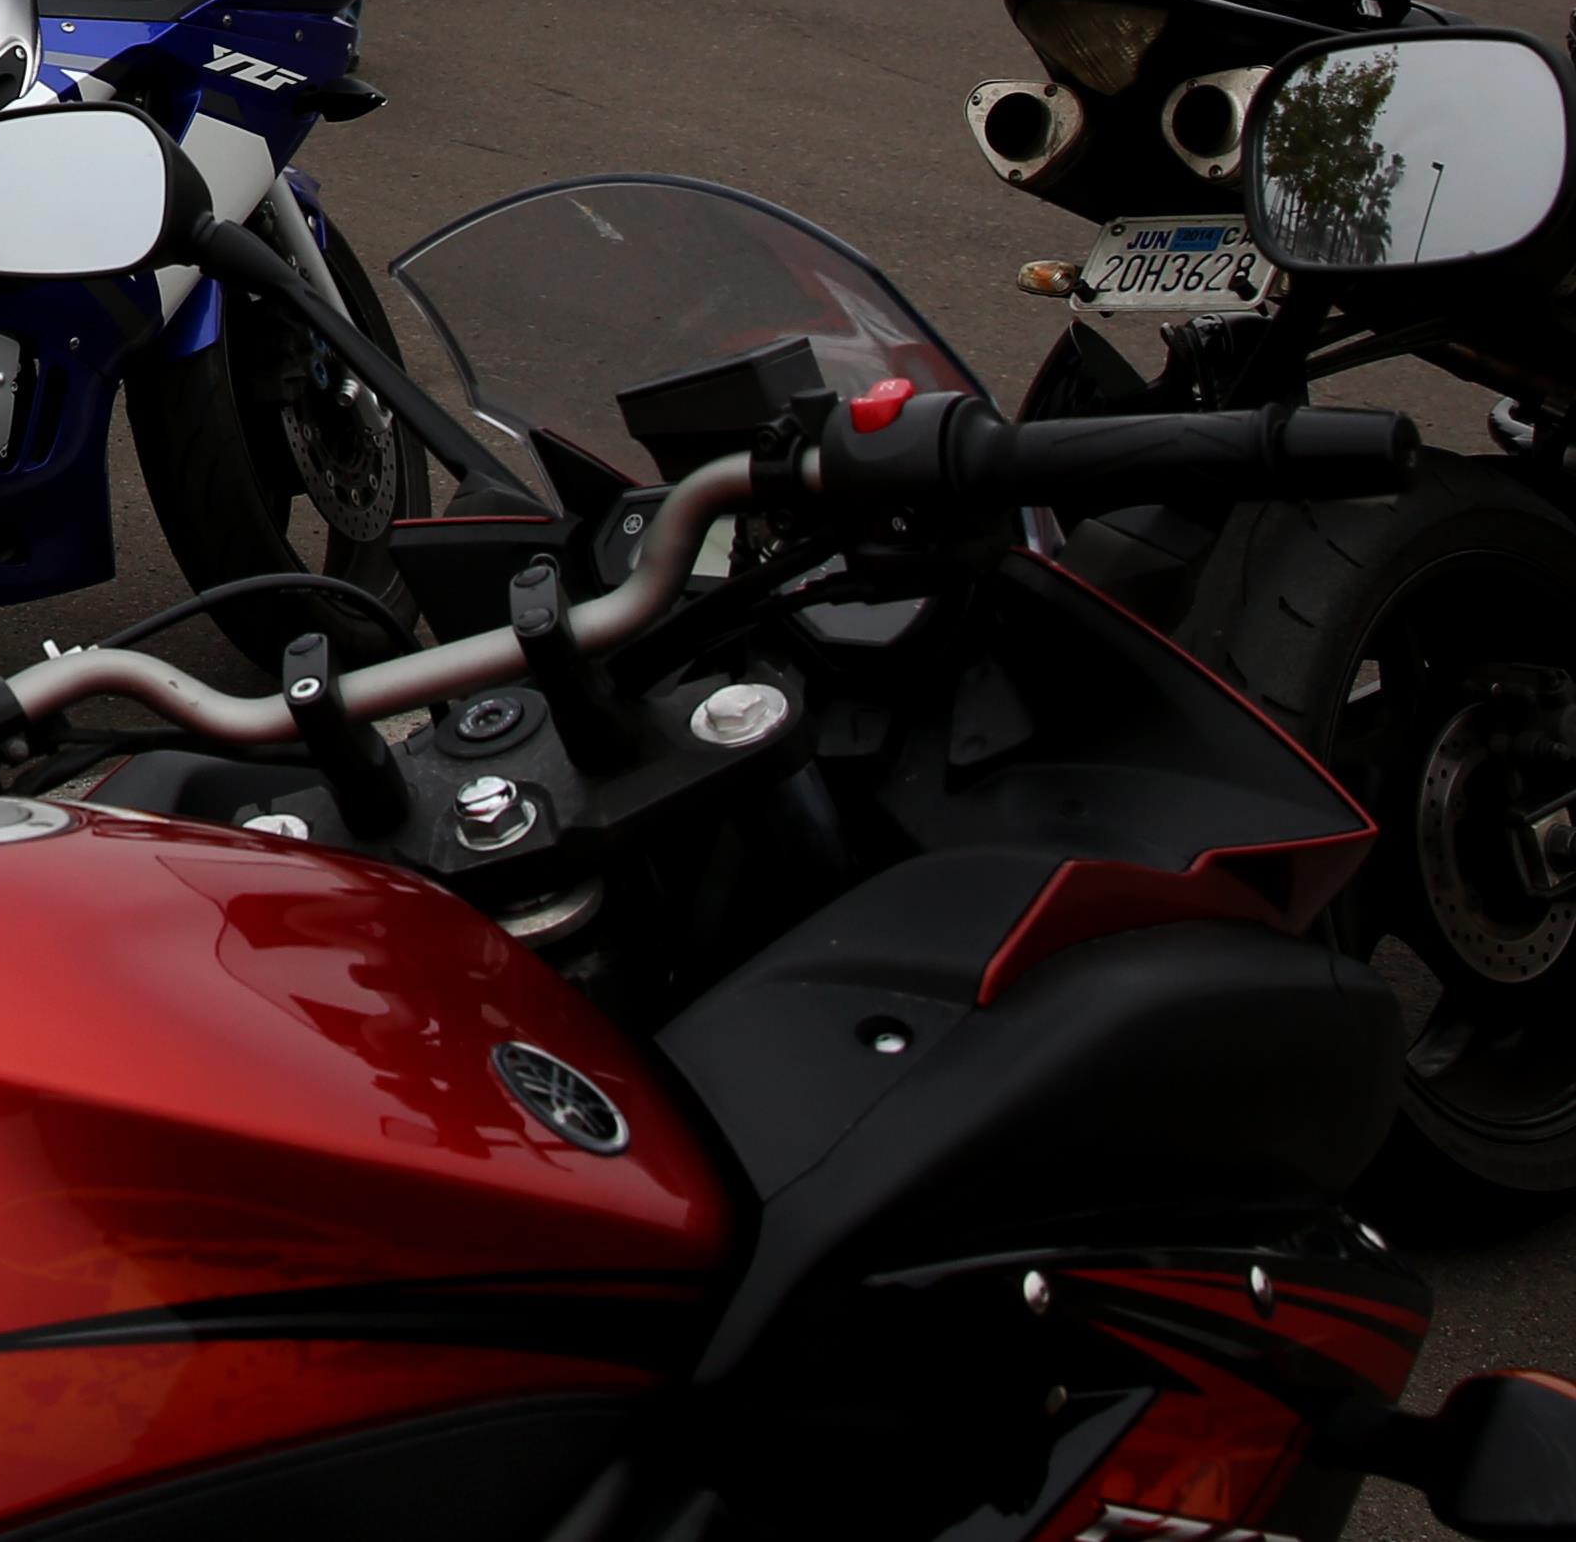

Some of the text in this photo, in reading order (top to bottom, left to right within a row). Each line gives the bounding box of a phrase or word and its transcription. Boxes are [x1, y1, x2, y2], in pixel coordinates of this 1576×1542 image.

[1127, 230, 1173, 250] JUN
[1182, 229, 1215, 241] 2014
[1096, 253, 1256, 293] 20H3628
